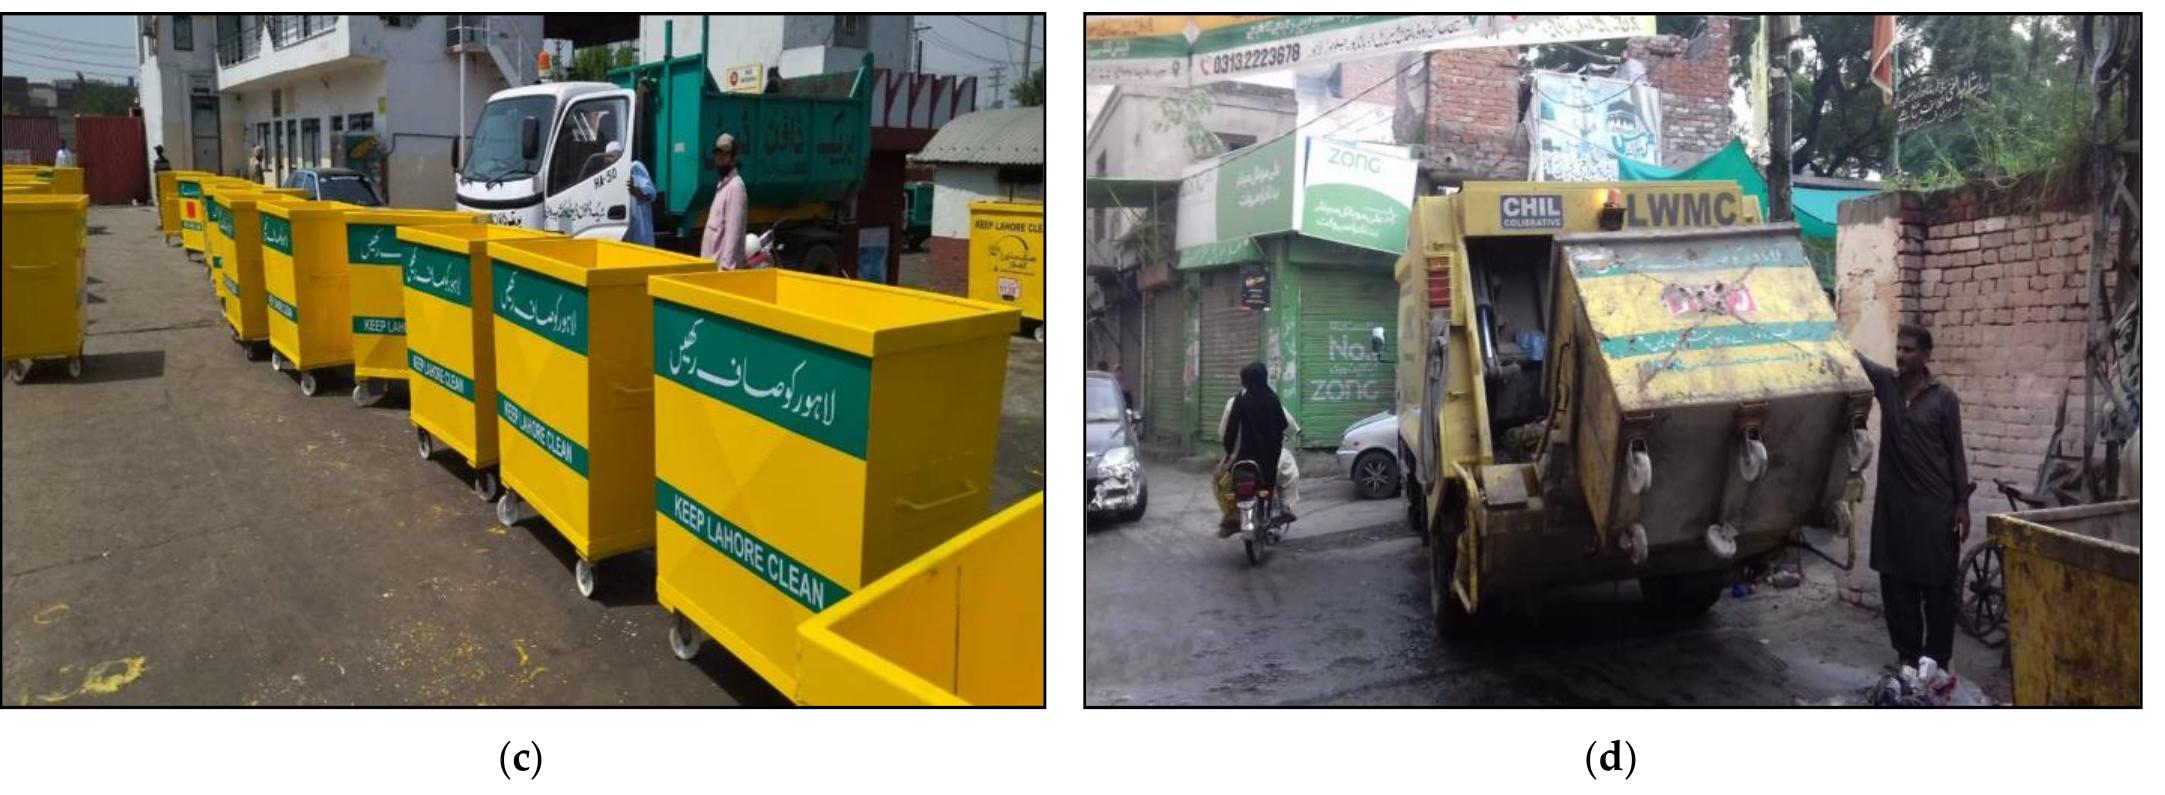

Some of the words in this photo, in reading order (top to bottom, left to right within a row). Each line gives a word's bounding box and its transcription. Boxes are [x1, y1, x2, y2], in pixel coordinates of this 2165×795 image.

[995, 221, 1026, 233] LAHORE
[1503, 197, 1561, 217] CHIL
[1626, 191, 1737, 227] LWMC
[363, 319, 386, 332] KEEP
[669, 317, 705, 377] رکھیں
[696, 355, 786, 398] صاف
[793, 386, 837, 426] لاہور
[520, 413, 546, 446] LAHORE
[546, 430, 573, 465] CLEAN
[674, 493, 705, 533] KEEP
[707, 515, 765, 573] LAHORE
[768, 553, 825, 610] CLEAN
